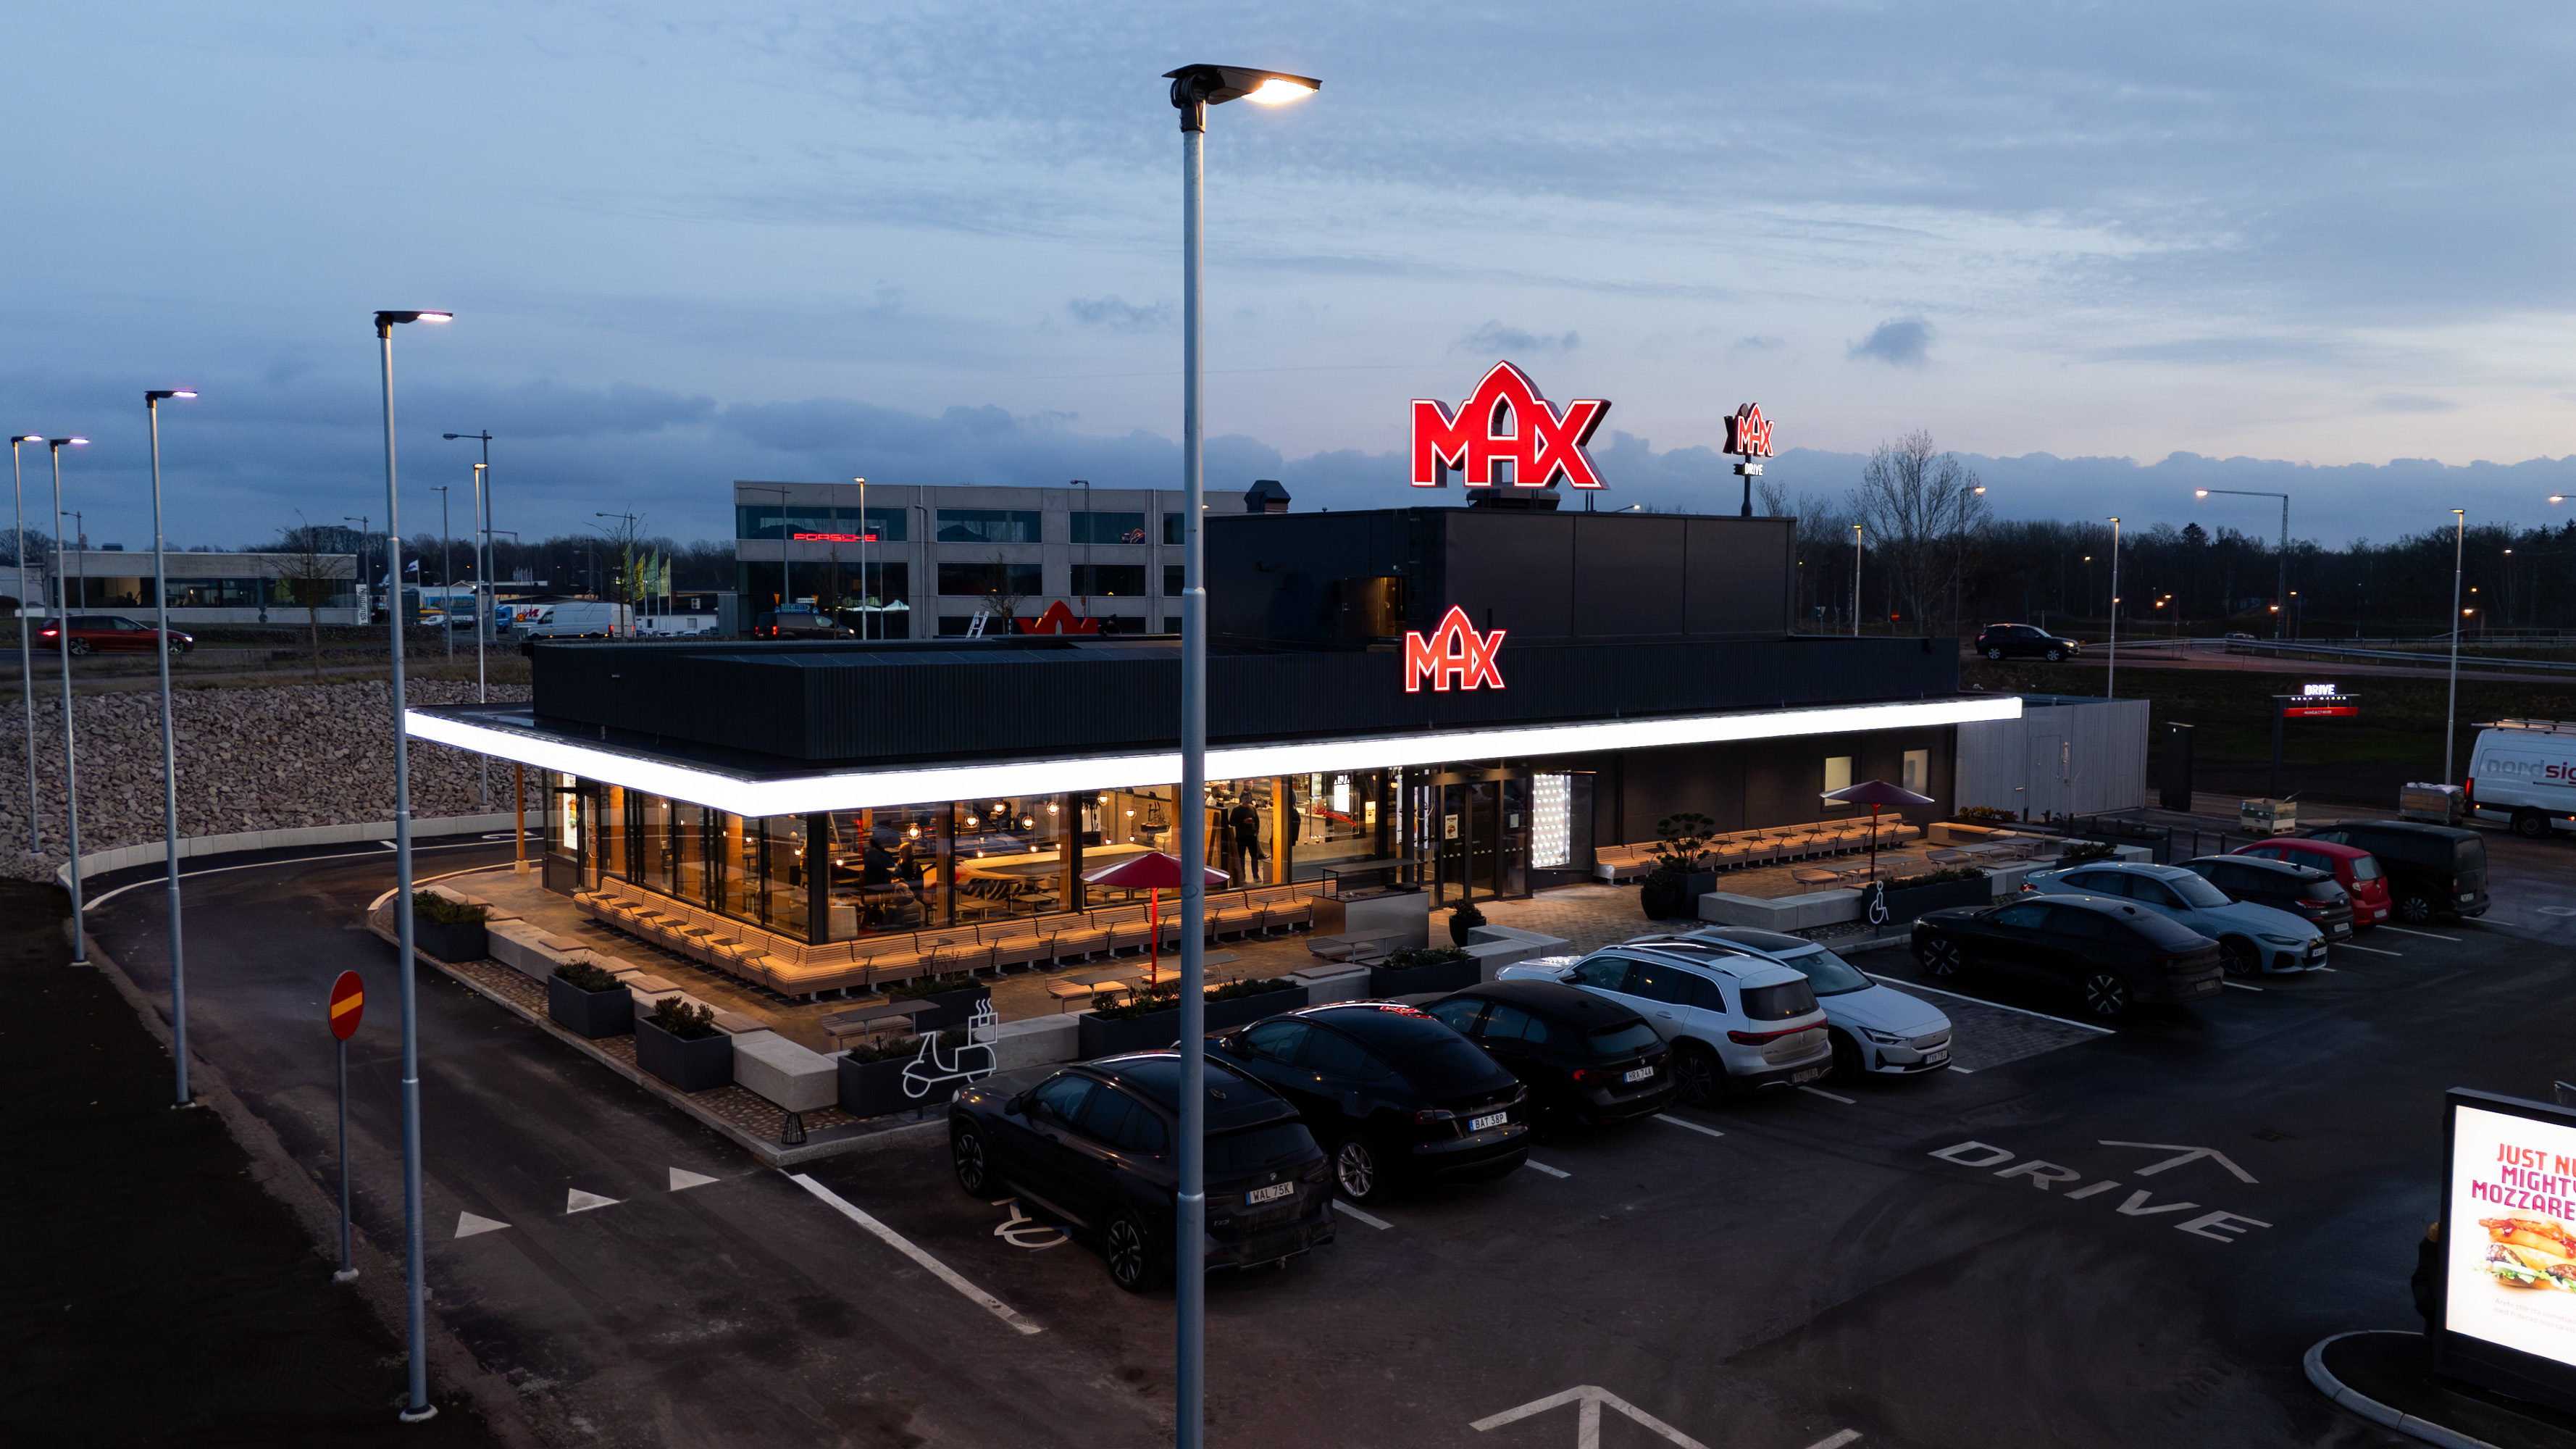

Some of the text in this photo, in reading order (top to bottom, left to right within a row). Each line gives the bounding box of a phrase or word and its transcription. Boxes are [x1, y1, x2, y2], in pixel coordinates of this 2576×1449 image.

[1410, 360, 1609, 490] MAX
[1737, 403, 1775, 457] MAX
[1744, 463, 1763, 475] DRIVE
[794, 533, 877, 542] PORSCHE
[1405, 604, 1507, 693] MAX
[2304, 684, 2335, 696] DRIVE
[1475, 1114, 1504, 1129] BAT 38P
[2497, 1143, 2548, 1171] JUST
[1253, 1183, 1290, 1202] WAL 75K
[1927, 1141, 2273, 1243] DRIVE
[2501, 1165, 2576, 1198] MIGHT
[2472, 1179, 2575, 1221] MOZZARE
[2493, 1307, 2509, 1316] med
[2542, 1311, 2576, 1324] comebac
